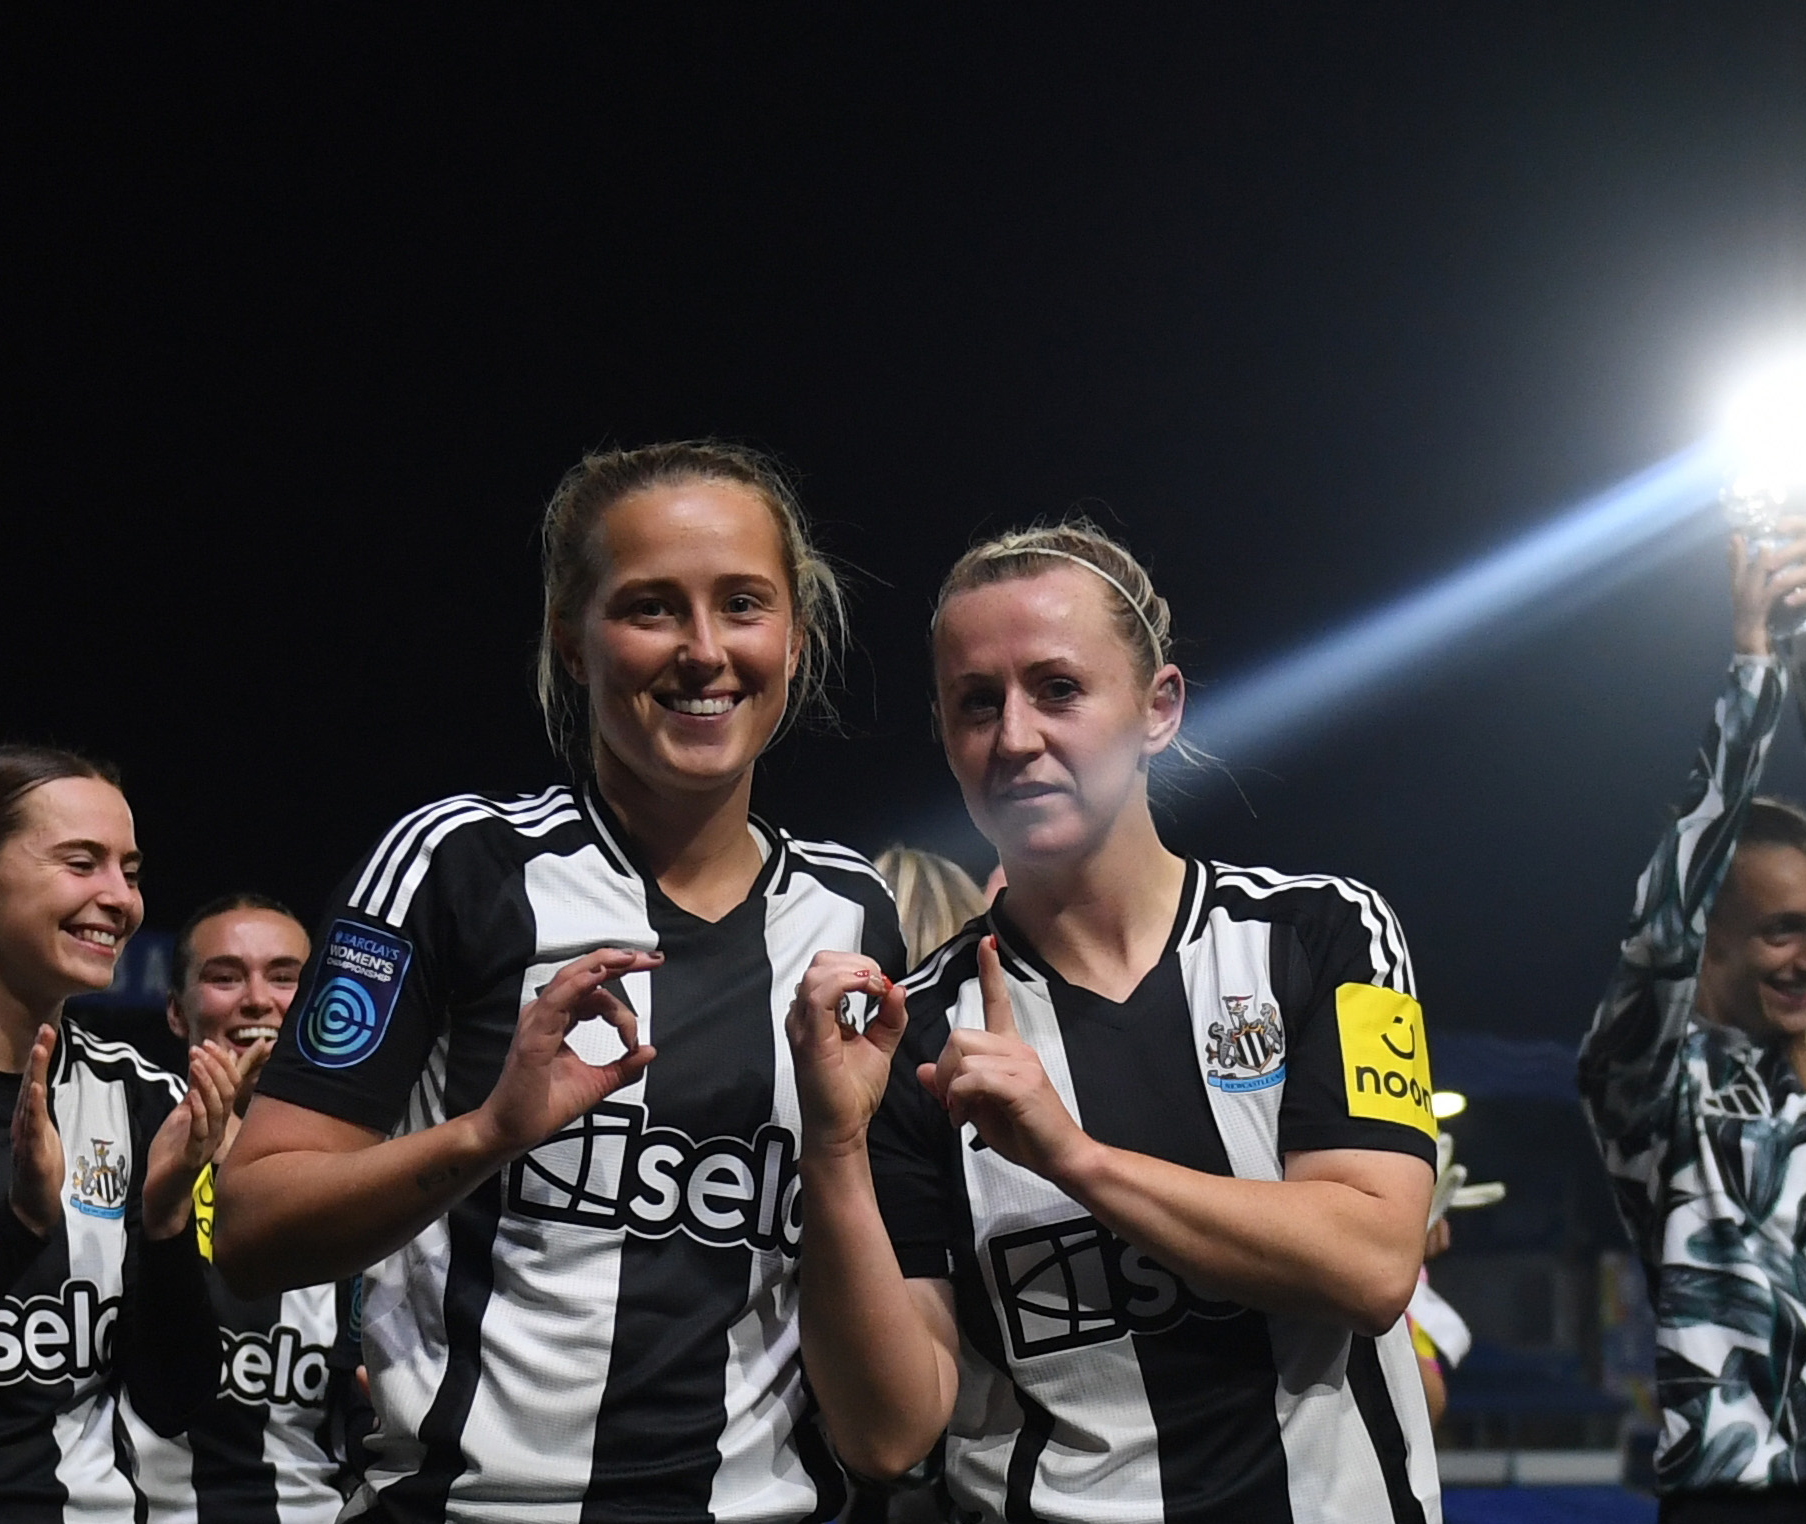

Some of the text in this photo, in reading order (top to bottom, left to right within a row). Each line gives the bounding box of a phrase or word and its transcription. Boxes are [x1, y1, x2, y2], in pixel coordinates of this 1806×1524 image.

[330, 944, 394, 974] WOMEN'S
[344, 934, 400, 960] BARCLAYS
[1355, 1066, 1434, 1119] noon
